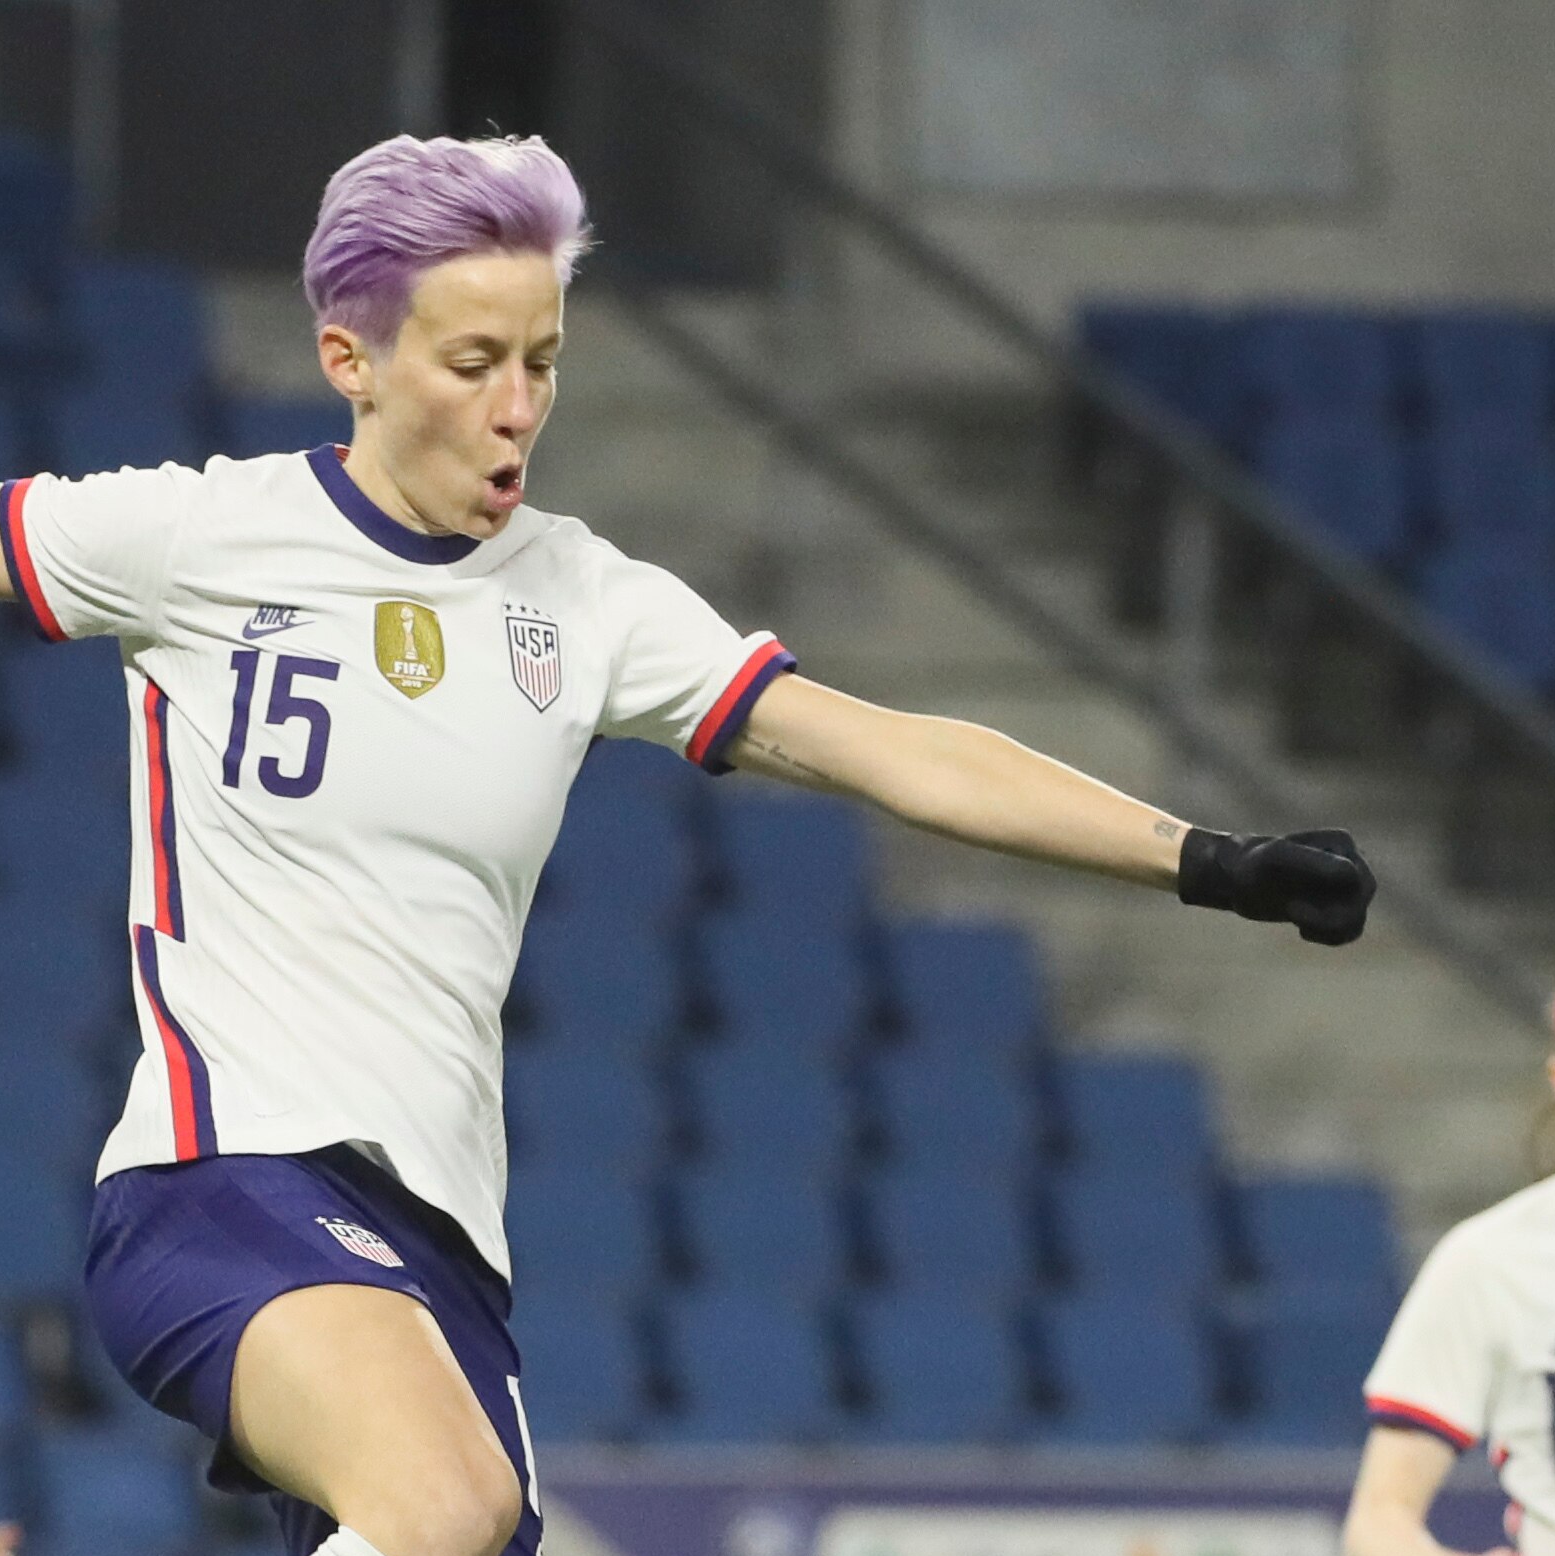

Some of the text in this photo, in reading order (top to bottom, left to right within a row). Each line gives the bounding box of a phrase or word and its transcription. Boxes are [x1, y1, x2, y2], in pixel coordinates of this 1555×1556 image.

[252, 605, 300, 626] NIKE
[513, 625, 555, 658] USA
[394, 661, 429, 677] FIFA
[222, 648, 341, 799] 15
